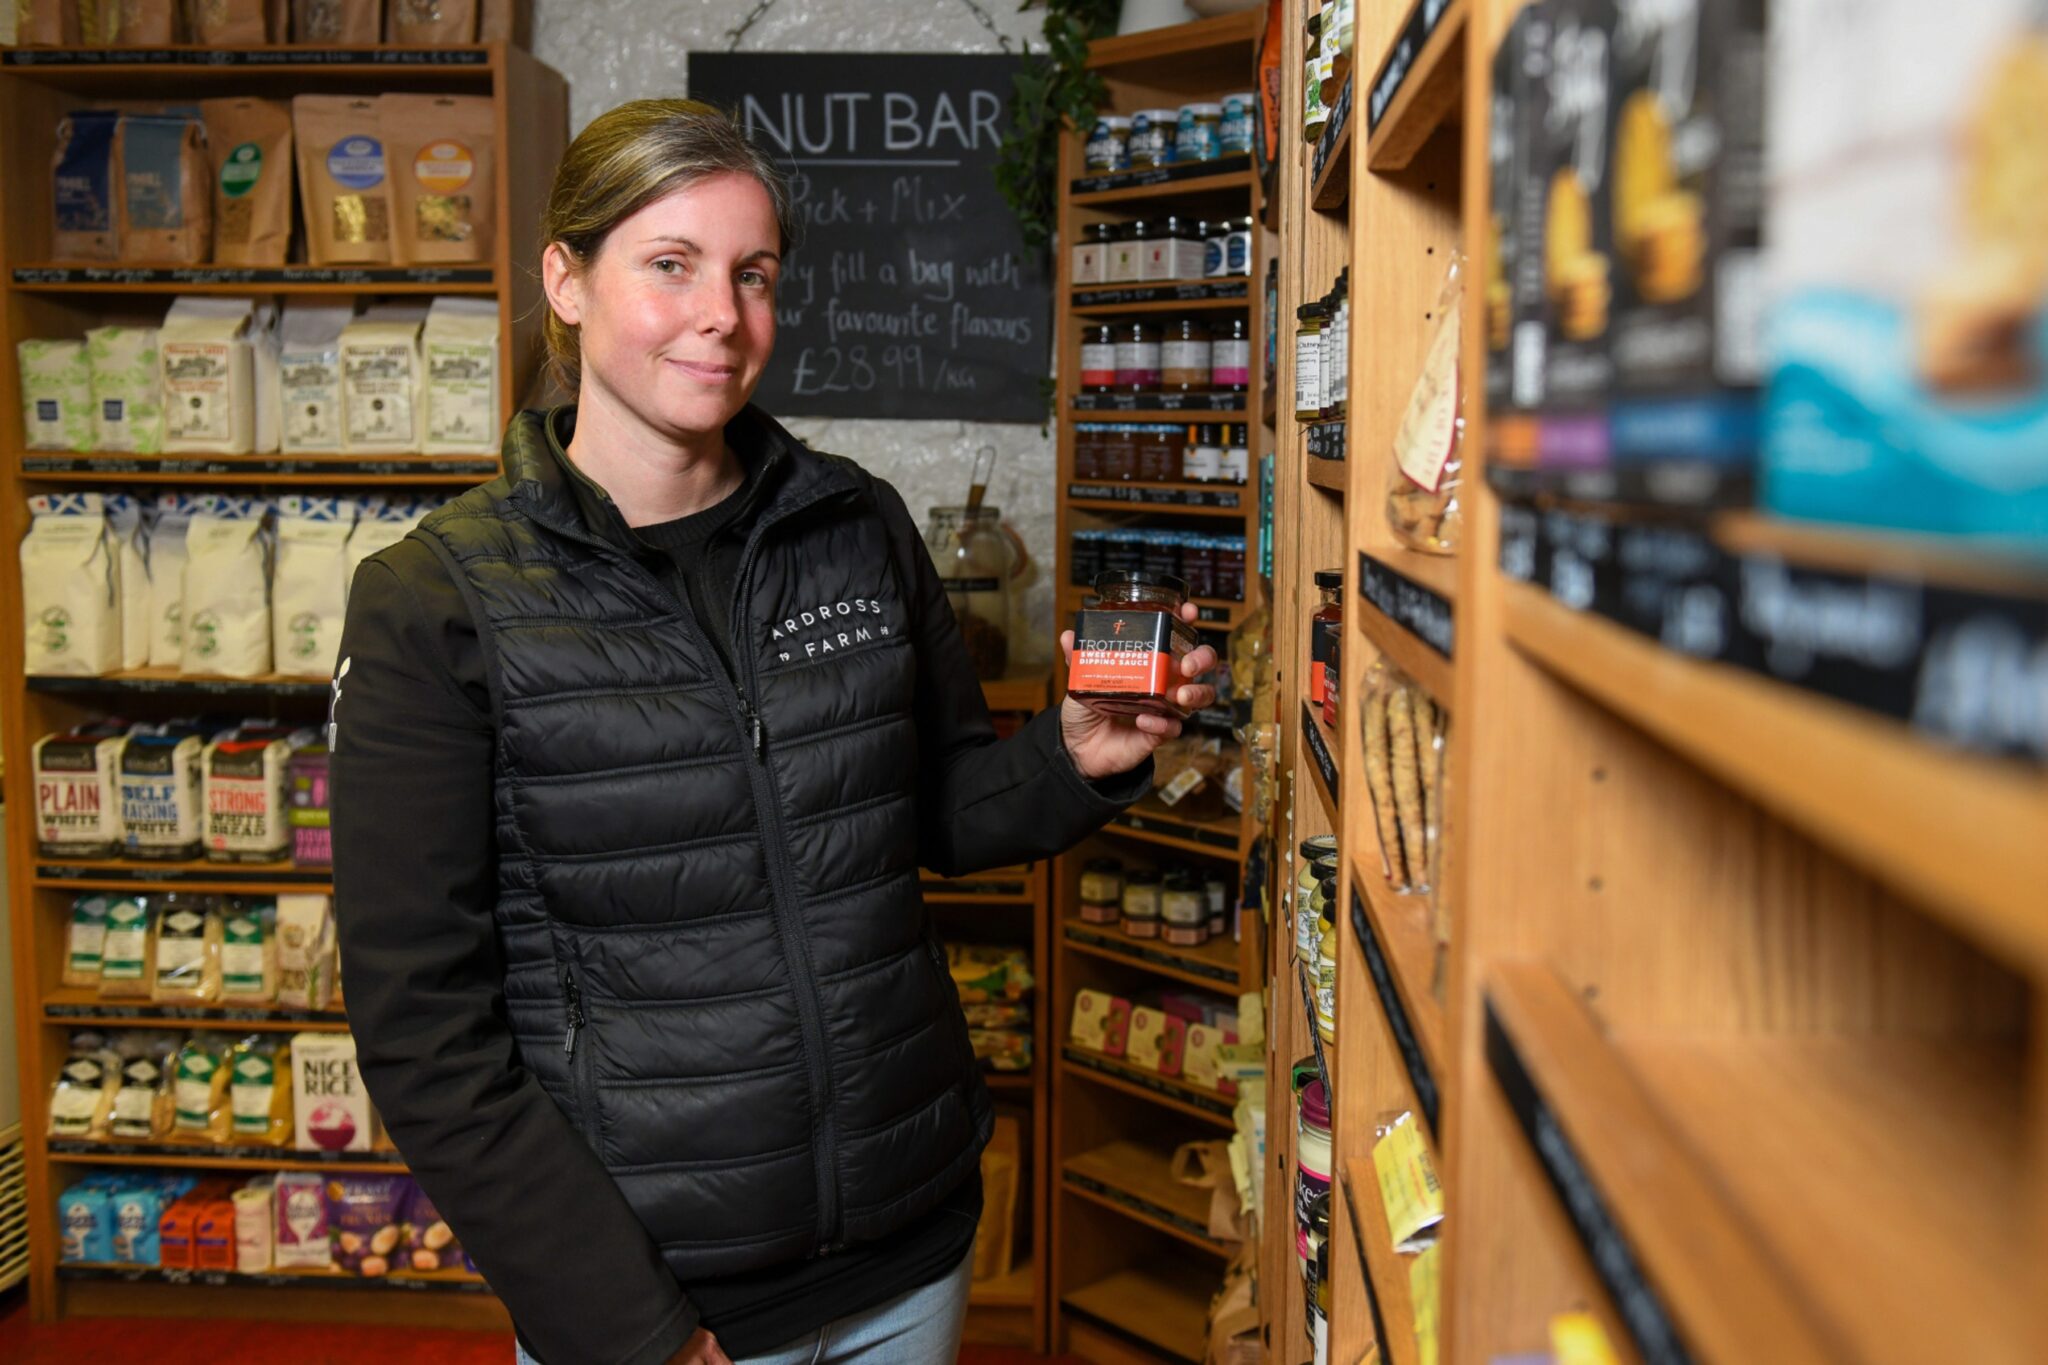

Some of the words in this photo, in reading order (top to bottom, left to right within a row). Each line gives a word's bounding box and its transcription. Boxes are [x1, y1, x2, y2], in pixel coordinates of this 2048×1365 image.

[743, 91, 870, 152] NUT
[884, 90, 1002, 150] BAR
[890, 175, 967, 223] Mix
[830, 250, 866, 293] fill
[879, 262, 898, 286] a
[909, 248, 956, 300] bag
[966, 254, 1020, 290] with
[822, 297, 939, 343] favourite
[950, 302, 1033, 349] flavours
[772, 599, 881, 640] ARDROSS
[804, 627, 872, 657] FARM
[1079, 639, 1155, 652] TROTTER'S
[1081, 650, 1111, 659] SWEET
[1114, 651, 1149, 659] PEPPER
[1079, 658, 1116, 666] DIPPING
[1118, 659, 1149, 667] SAUCE
[40, 783, 100, 812] PLAIN
[209, 789, 266, 813] STRONG
[42, 814, 99, 826] WHITE
[303, 1059, 355, 1078] NICE
[304, 1079, 356, 1096] RICE
